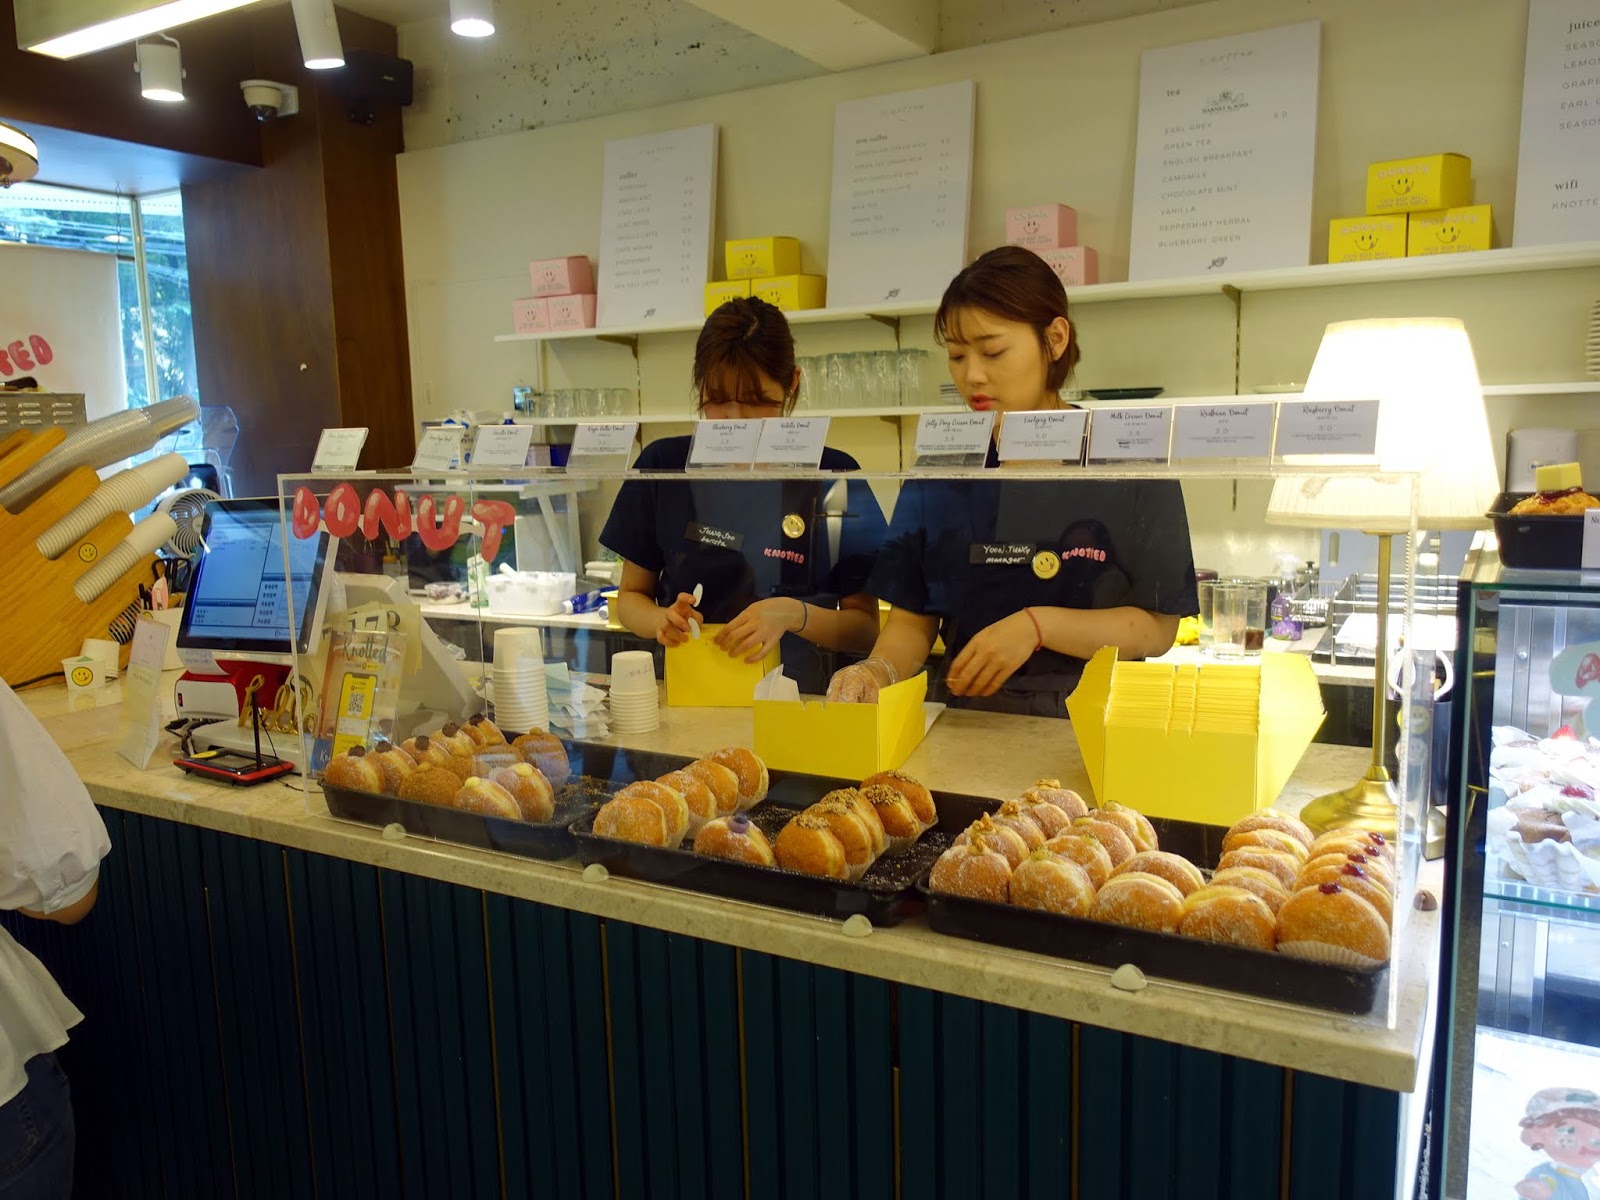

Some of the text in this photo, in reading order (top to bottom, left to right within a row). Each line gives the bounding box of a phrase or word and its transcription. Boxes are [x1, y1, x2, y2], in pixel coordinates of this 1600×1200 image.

[1567, 19, 1600, 34] juice
[1166, 89, 1181, 97] tea
[1163, 138, 1212, 151] GREEN TEA
[1162, 149, 1254, 167] ENGLISH BREAKFAST
[1554, 178, 1579, 191] wifi
[1160, 183, 1239, 200] CHOCOLATE MINT
[1159, 205, 1197, 216] VANILLA
[1158, 234, 1242, 248] BLUEBERRY GREEN
[1229, 408, 1250, 417] Donut
[1334, 404, 1356, 413] Donut
[969, 417, 986, 426] Donut
[1048, 415, 1066, 423] Donut
[1145, 411, 1163, 420] Donut
[292, 483, 517, 564] DONUT
[763, 546, 805, 565] KNOTTED
[1061, 546, 1107, 563] KNOTTED
[342, 633, 389, 664] Knotted
